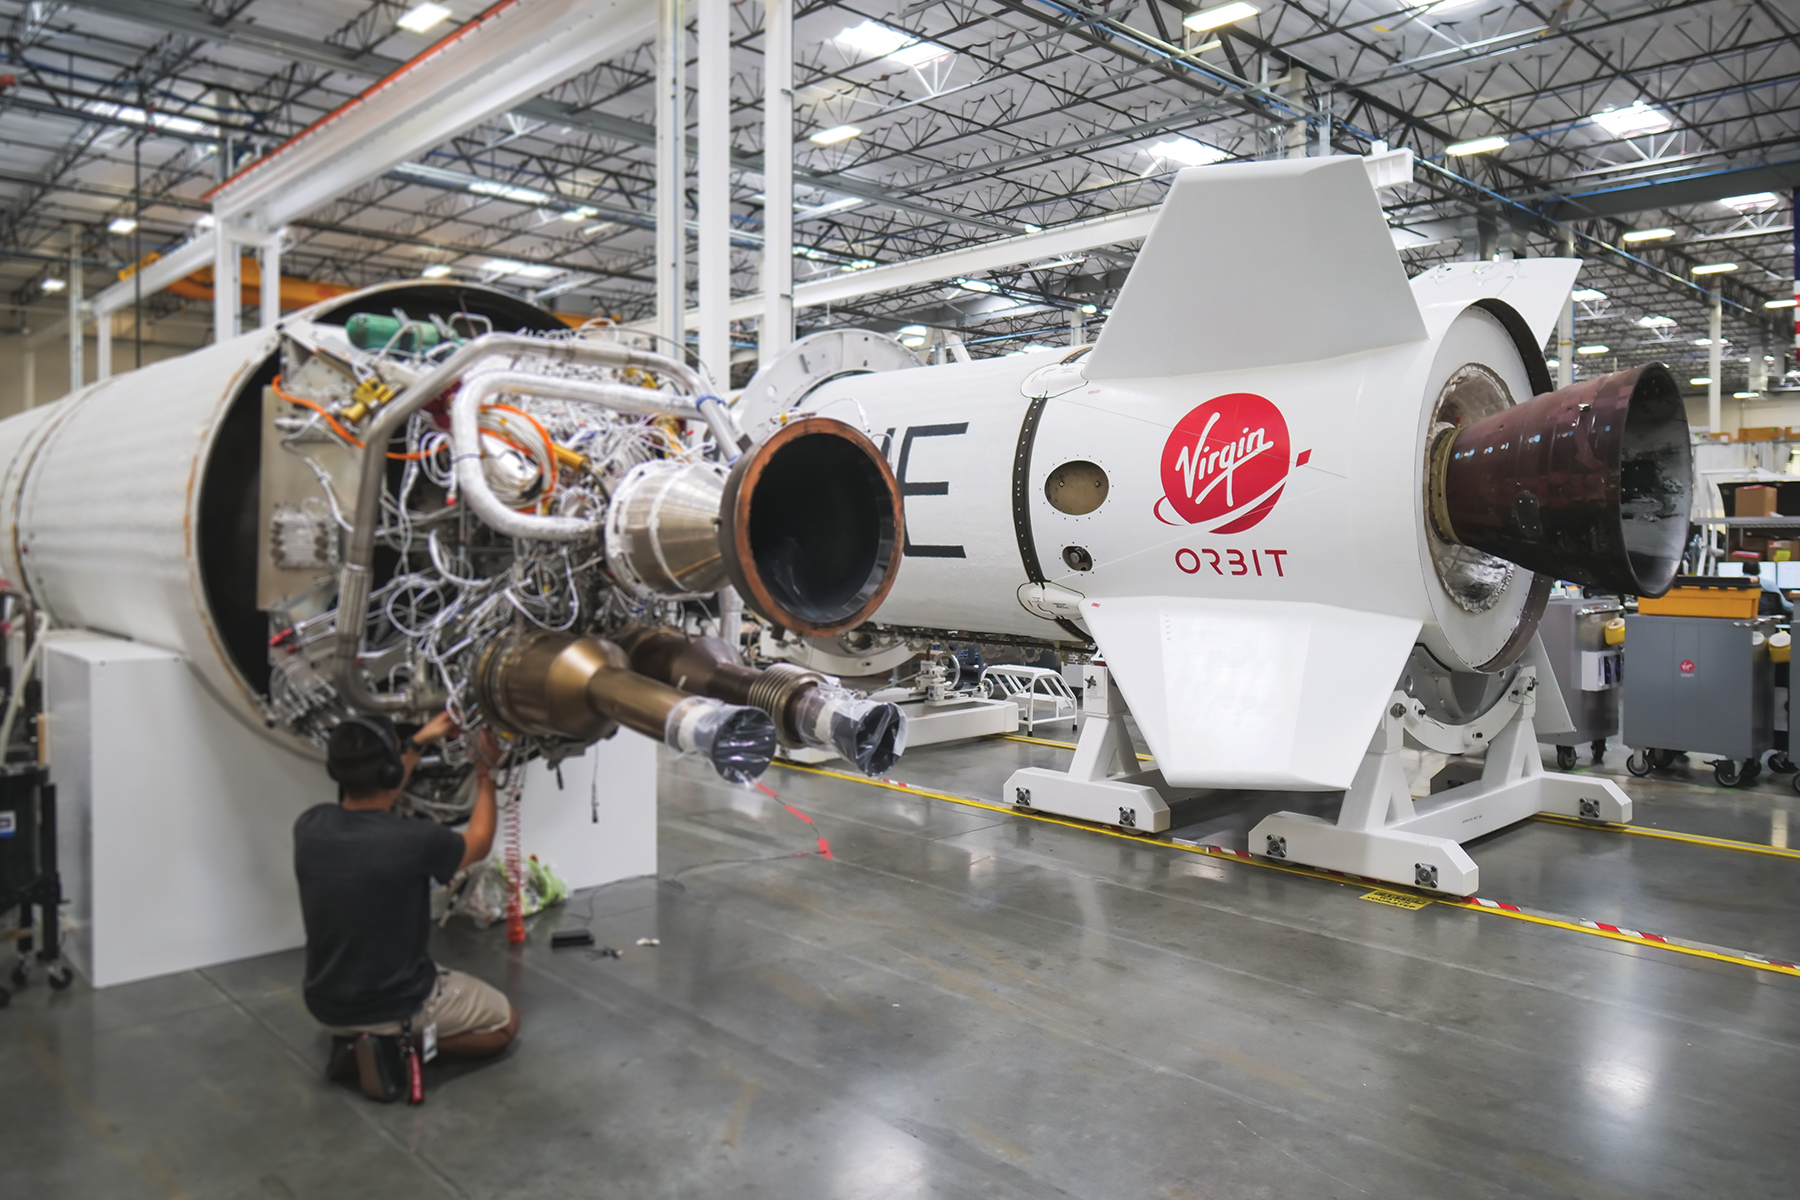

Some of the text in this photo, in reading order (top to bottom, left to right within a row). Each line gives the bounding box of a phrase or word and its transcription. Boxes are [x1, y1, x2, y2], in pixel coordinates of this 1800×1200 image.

[880, 422, 969, 558] E
[1175, 412, 1274, 507] Virgin
[1175, 548, 1288, 577] ORBIT
